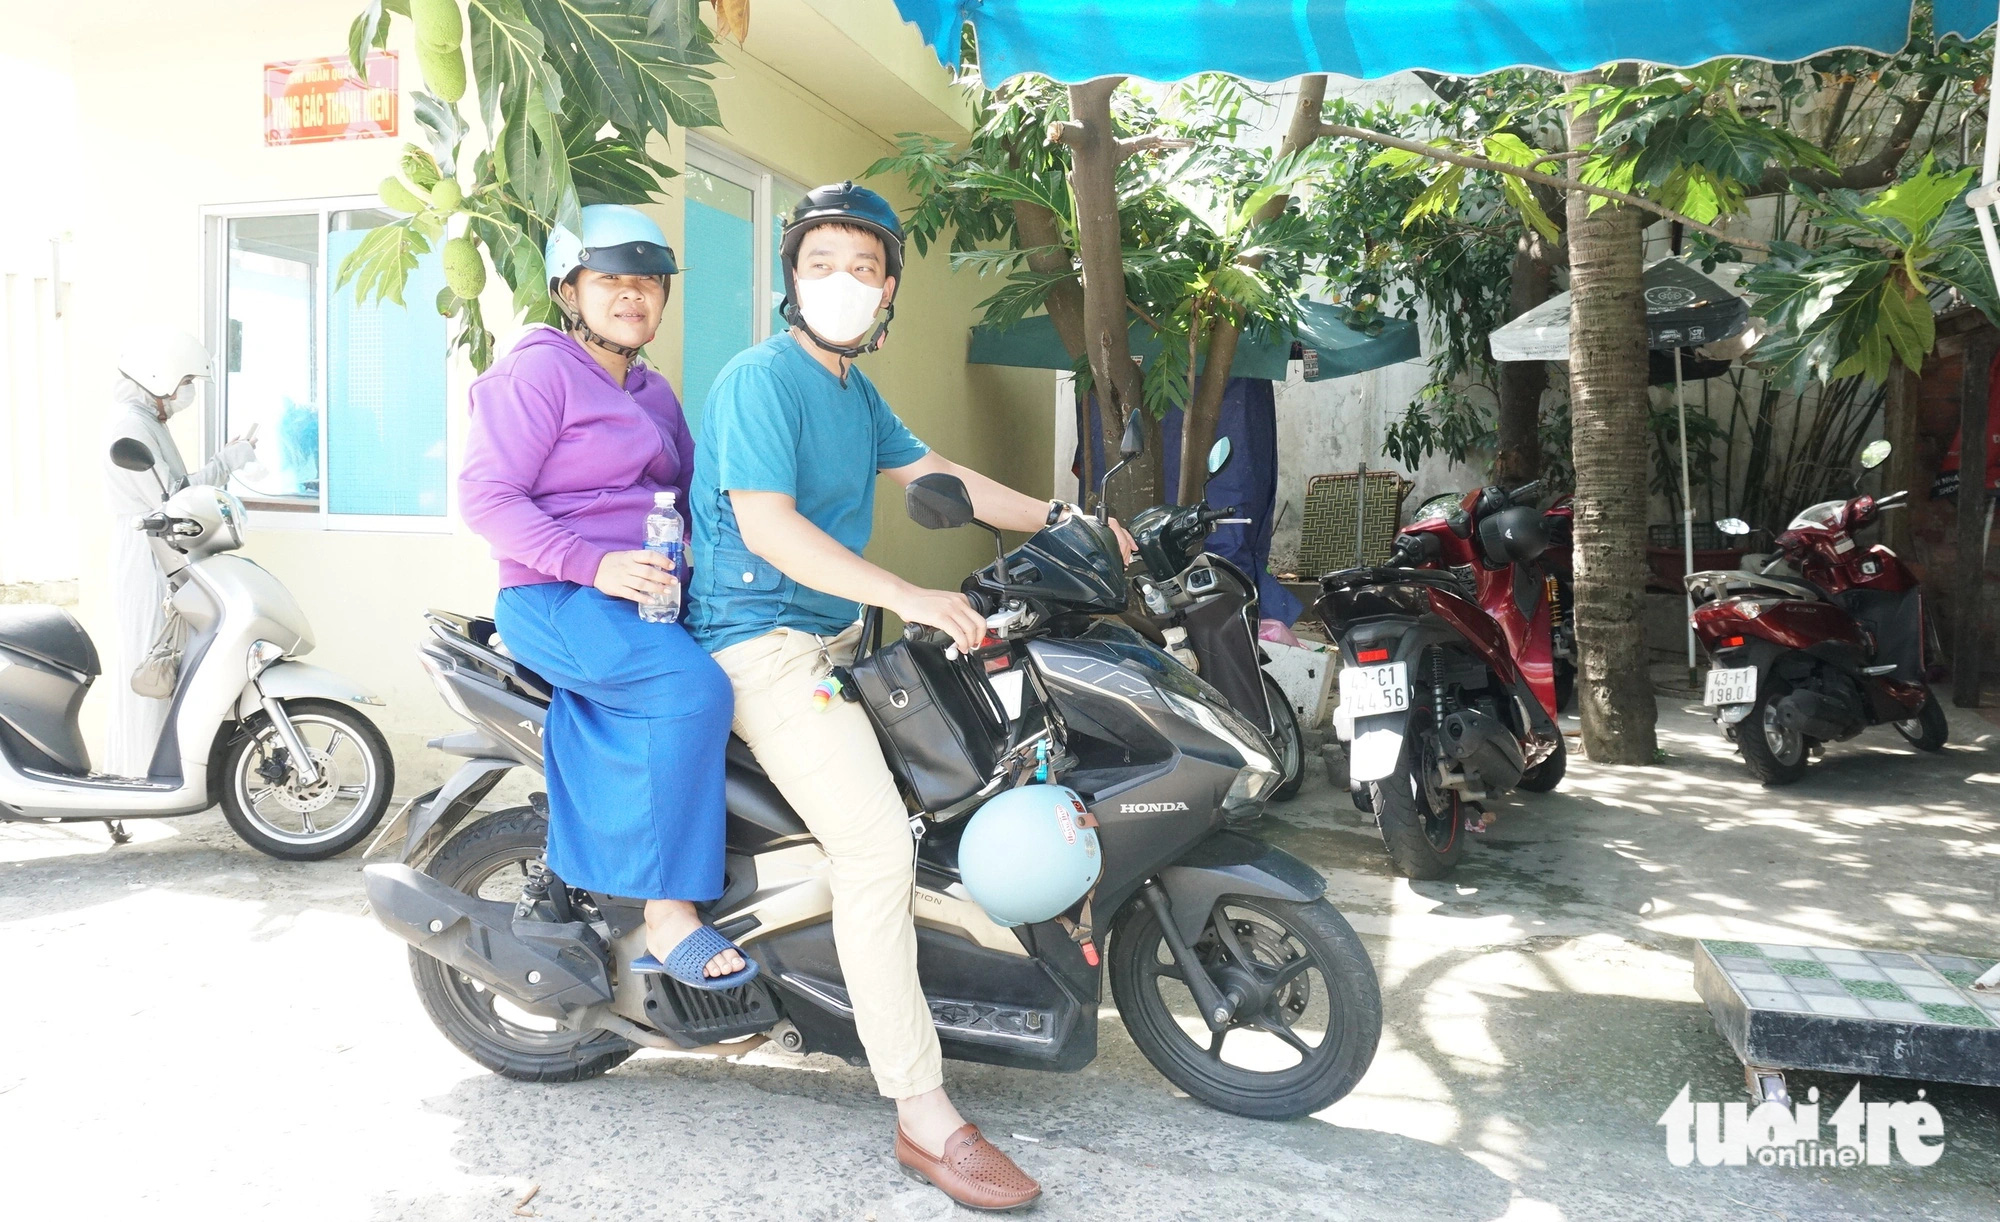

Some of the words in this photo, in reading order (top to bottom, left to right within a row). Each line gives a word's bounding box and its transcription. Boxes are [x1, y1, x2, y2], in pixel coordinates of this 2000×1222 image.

[302, 87, 323, 127] GÁC
[326, 89, 360, 125] THANH
[363, 81, 389, 122] NIÊN
[1351, 666, 1394, 690] 43-C1
[1120, 802, 1189, 813] HONDA
